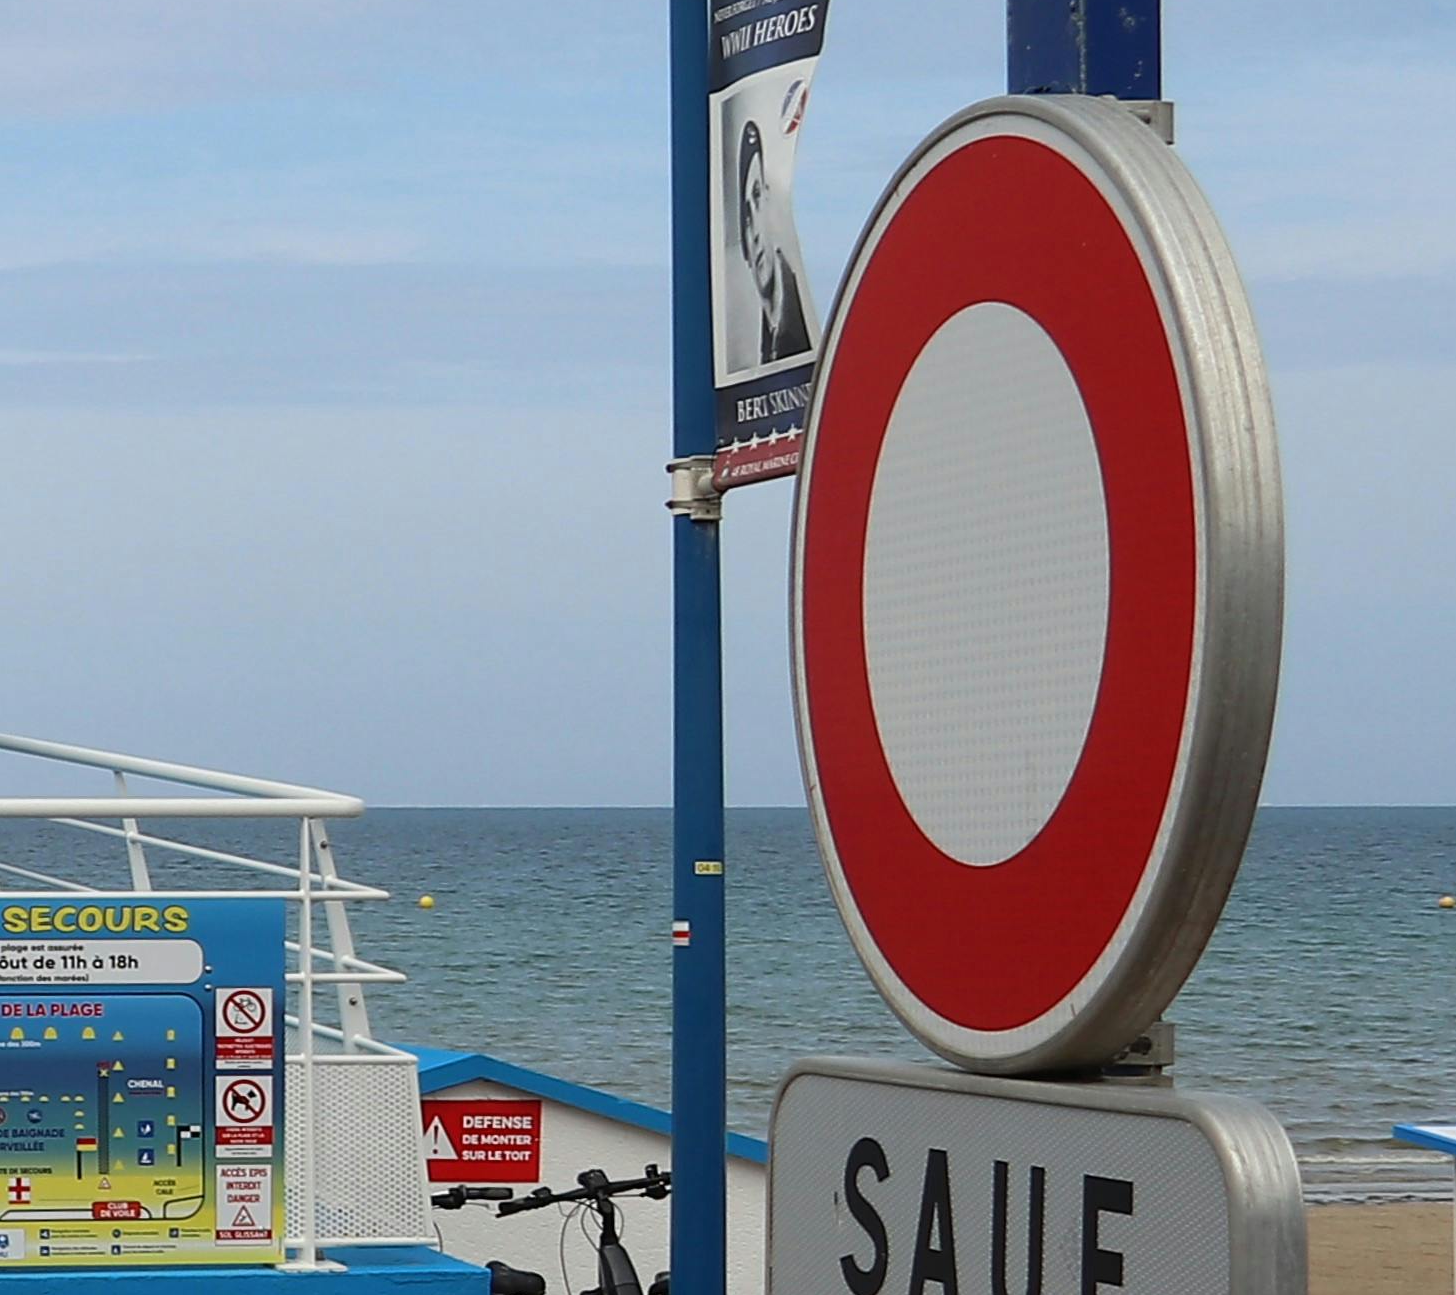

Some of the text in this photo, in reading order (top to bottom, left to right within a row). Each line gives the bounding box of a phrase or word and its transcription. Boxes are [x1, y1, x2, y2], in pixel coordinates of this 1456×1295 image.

[722, 4, 819, 60] WWII HEROES
[737, 395, 769, 422] BERT
[3, 906, 190, 934] SECOURS
[1, 945, 28, 954] plage
[47, 944, 84, 952] assurée
[33, 956, 55, 970] de
[61, 955, 87, 969] 11h
[92, 955, 104, 970] à
[109, 956, 139, 970] 18h
[1, 1004, 21, 1017] DE
[27, 1004, 46, 1017] LA
[51, 1004, 102, 1017] PLAGE
[127, 1080, 164, 1088] CHENAL
[462, 1116, 532, 1130] DEFENSE
[12, 1129, 64, 1138] BAIGNADE
[462, 1134, 532, 1145] DE MONTER
[462, 1150, 531, 1161] SUR LE TOIT
[220, 1167, 268, 1177] ACCÈS EPIS
[226, 1181, 261, 1190] INTERDIT
[227, 1194, 260, 1203] DANGER
